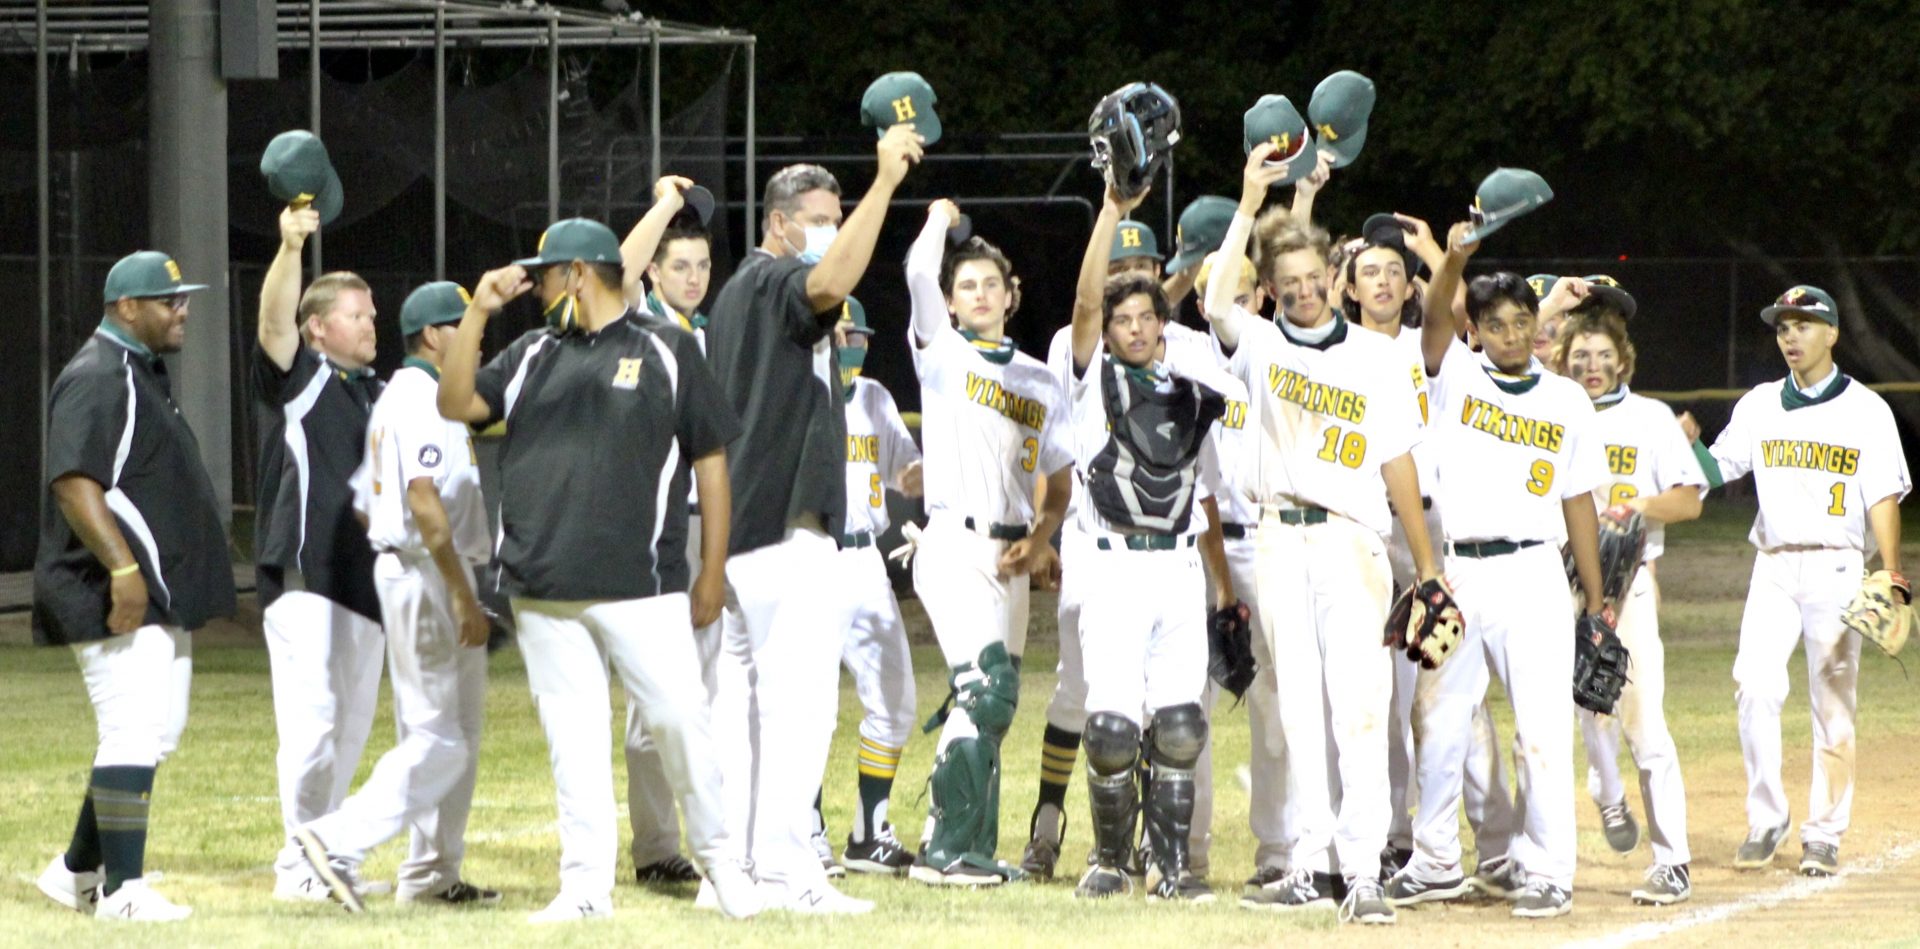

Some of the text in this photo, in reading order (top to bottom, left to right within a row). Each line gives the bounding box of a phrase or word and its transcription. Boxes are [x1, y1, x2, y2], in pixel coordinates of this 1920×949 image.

[892, 95, 916, 122] H
[1120, 227, 1141, 248] H
[616, 357, 643, 385] H
[966, 371, 1047, 433] VIKINGS
[1268, 363, 1367, 425] VIKINGS
[1461, 395, 1564, 454] VIKINGS
[1021, 436, 1039, 474] 3
[1317, 425, 1368, 470] 18
[1761, 438, 1860, 476] VIKINGS
[869, 473, 882, 508] 5
[1525, 458, 1555, 498] 9
[1827, 481, 1847, 517] 1
